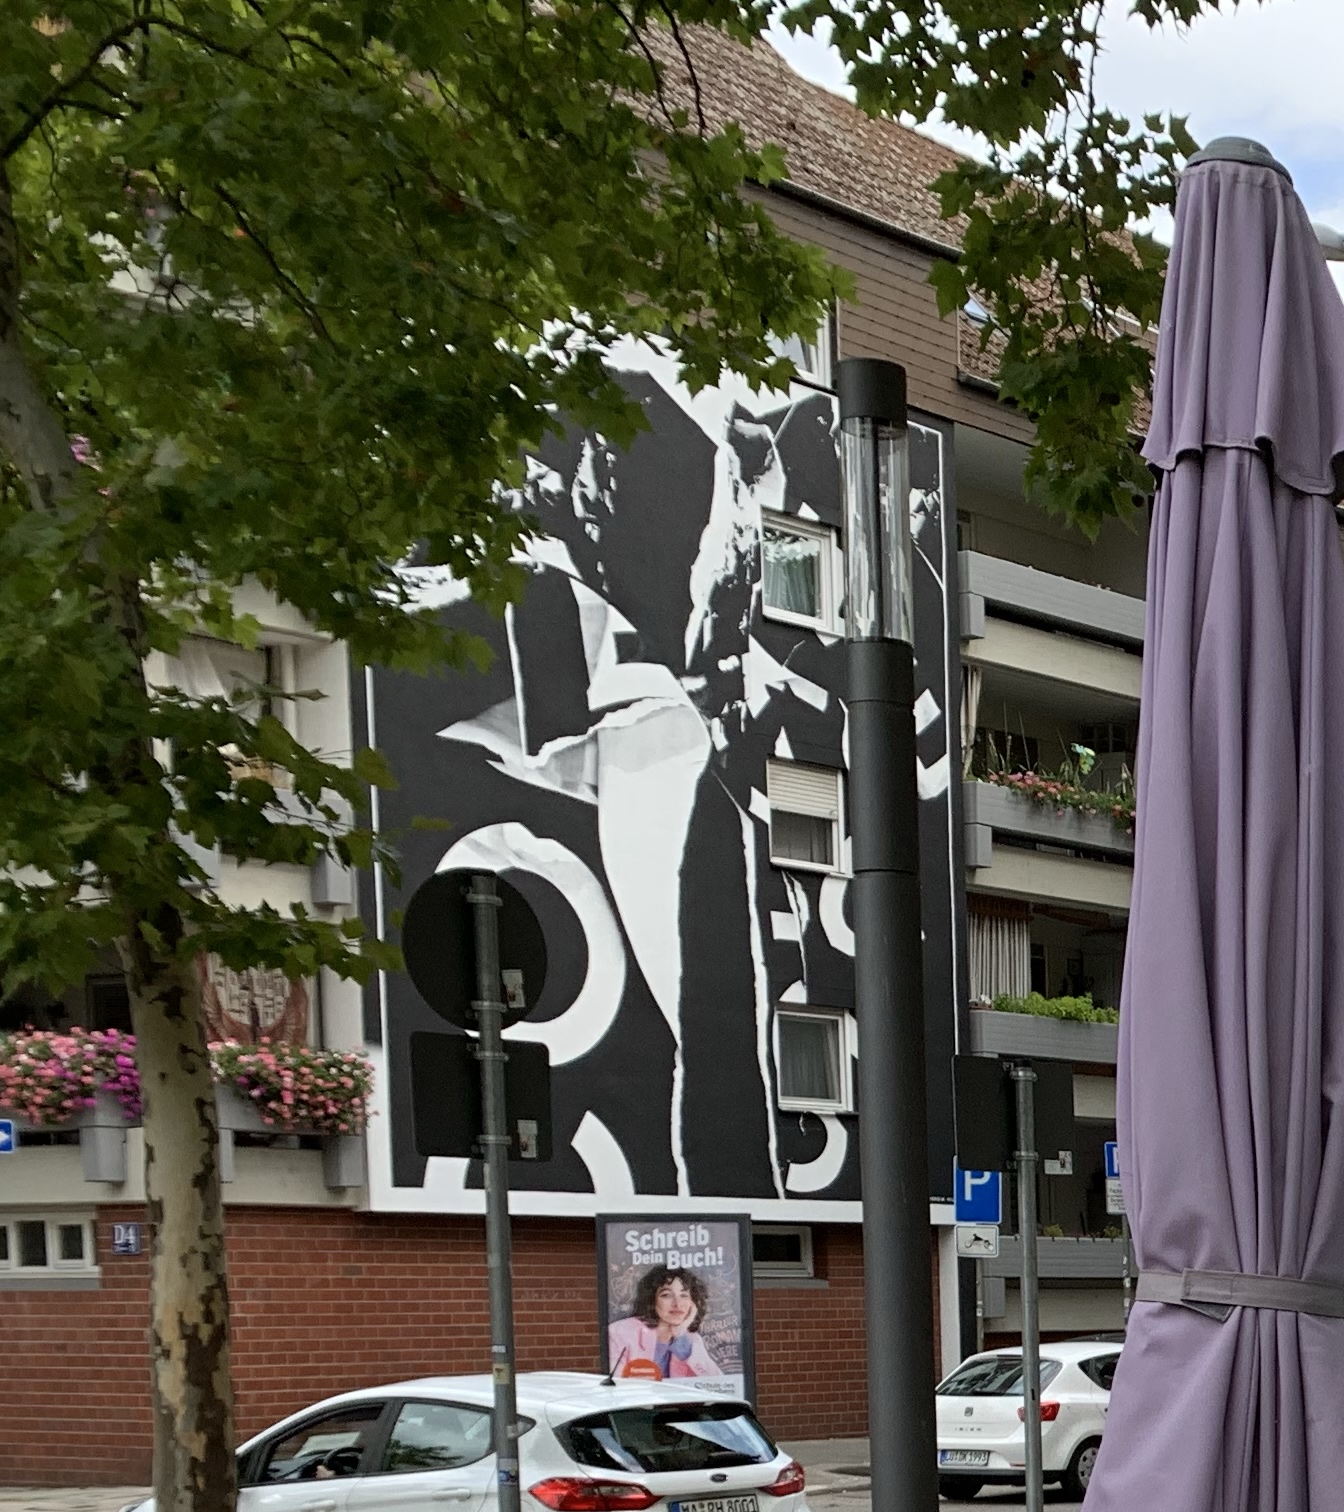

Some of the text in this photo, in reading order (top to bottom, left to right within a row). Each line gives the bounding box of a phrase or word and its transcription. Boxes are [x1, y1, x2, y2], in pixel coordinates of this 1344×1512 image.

[964, 1170, 991, 1201] P
[114, 1225, 135, 1243] D4
[625, 1224, 710, 1251] Schreib
[632, 1247, 724, 1270] Dein Buch!
